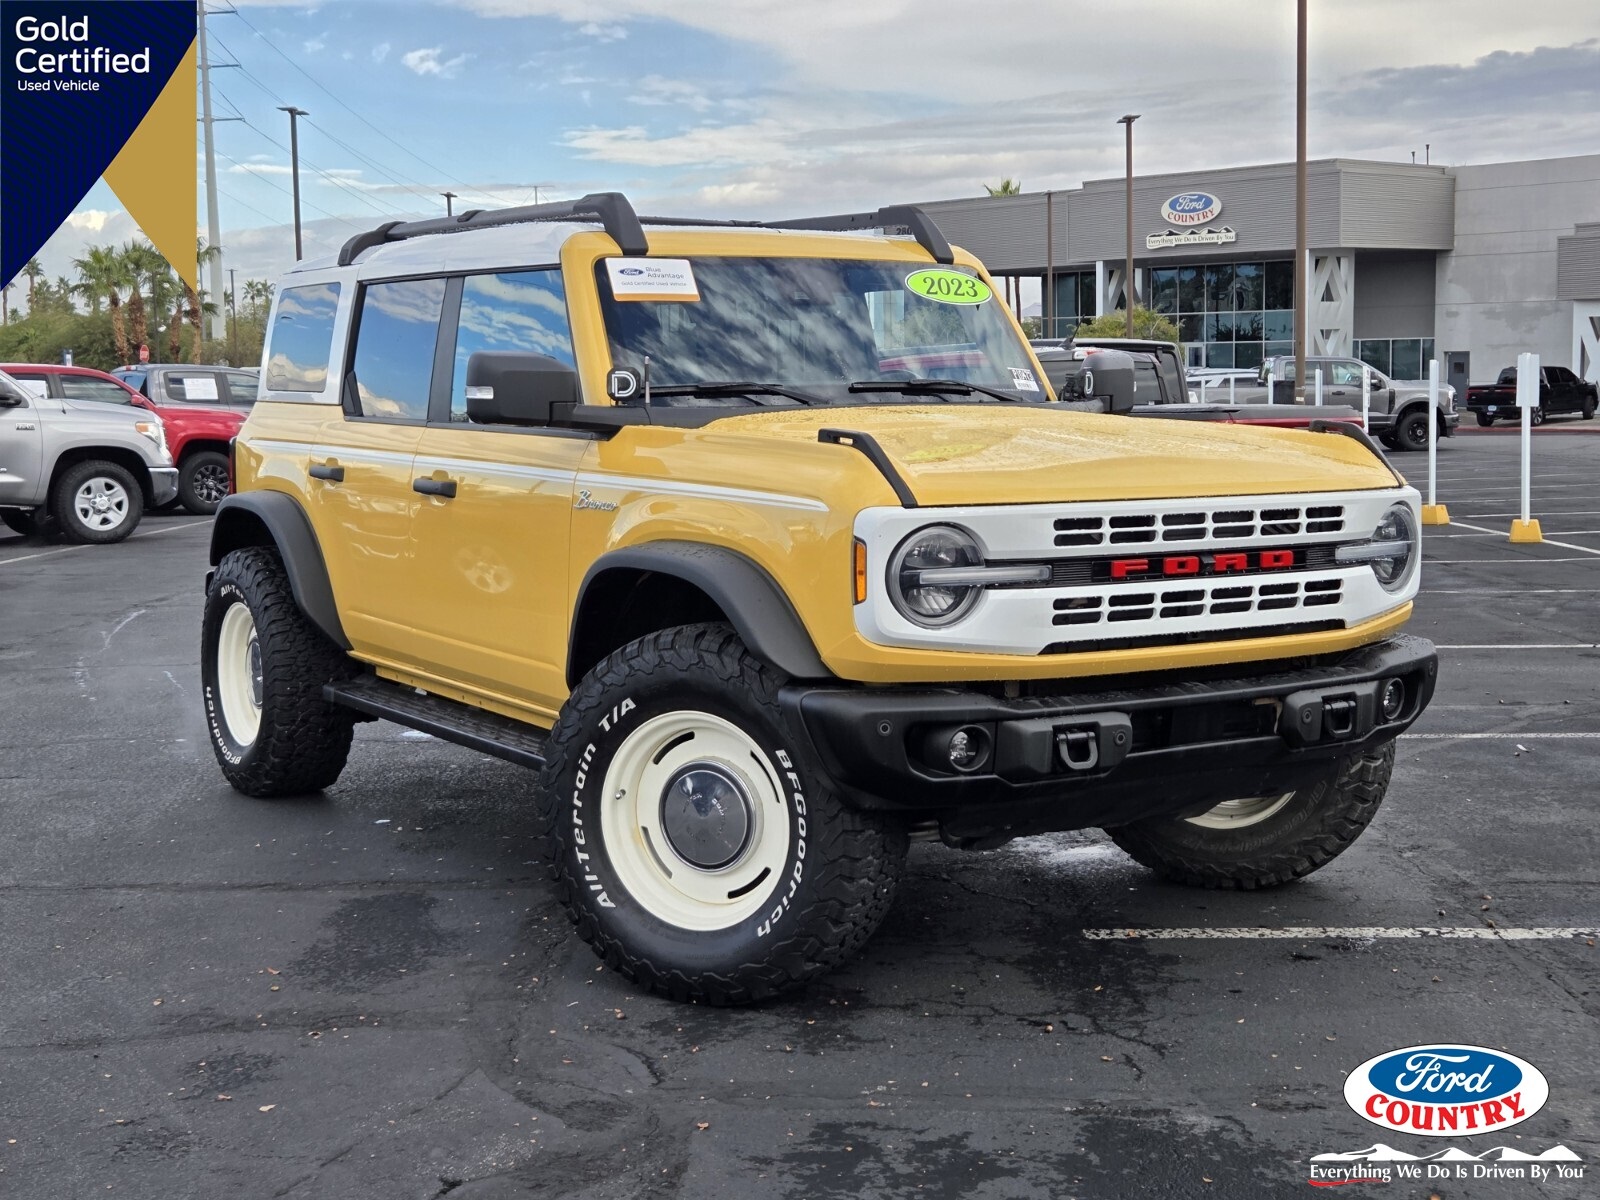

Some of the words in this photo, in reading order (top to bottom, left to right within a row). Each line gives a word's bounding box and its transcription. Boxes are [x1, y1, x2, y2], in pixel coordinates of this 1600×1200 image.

[1175, 195, 1206, 211] Ford
[1167, 208, 1216, 223] COUNTRY
[1147, 237, 1174, 246] Everything
[1198, 234, 1215, 242] Driven
[647, 272, 684, 280] Advantage
[922, 276, 979, 298] 2023
[1111, 550, 1294, 578] FORD
[206, 686, 242, 765] BFGoodrich
[572, 743, 616, 908] All-Terrain
[757, 749, 807, 938] BFGoodrich
